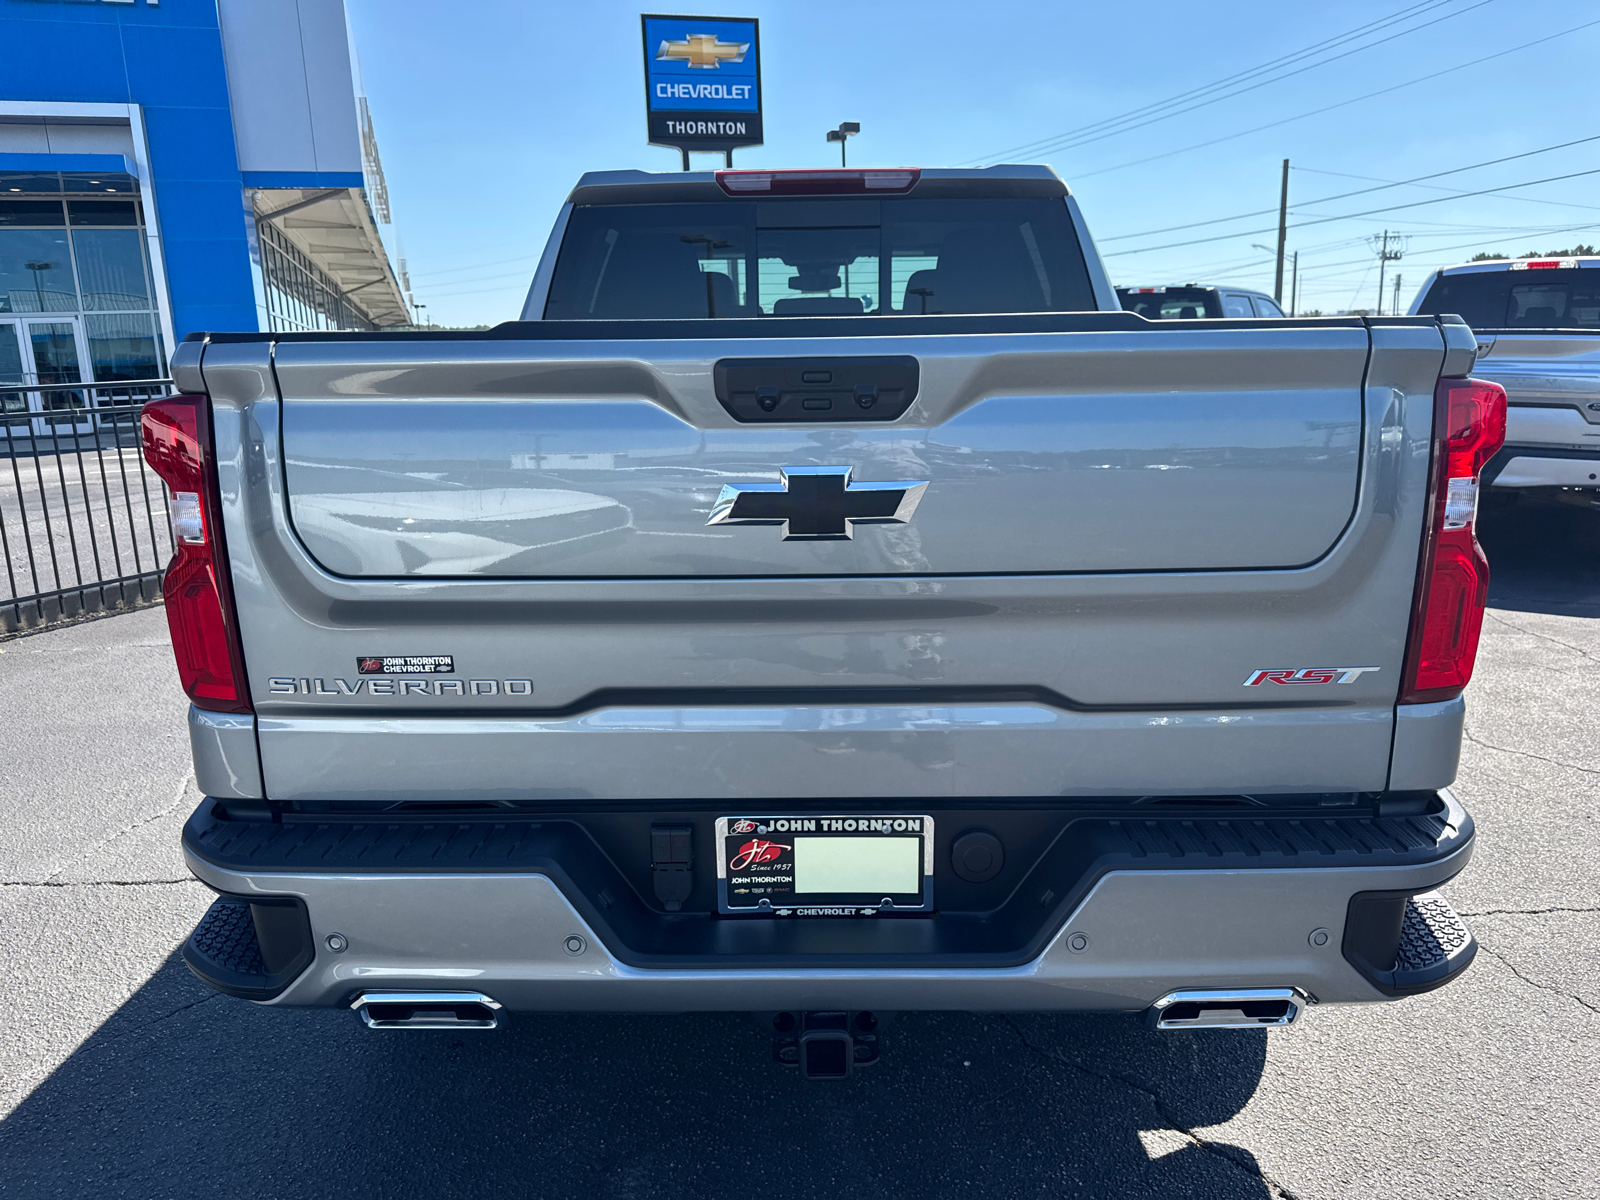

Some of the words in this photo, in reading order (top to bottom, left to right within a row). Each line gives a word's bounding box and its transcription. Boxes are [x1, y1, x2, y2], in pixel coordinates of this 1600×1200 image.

[656, 83, 752, 99] CHEVROLET
[666, 121, 746, 135] THORNTON
[383, 658, 404, 666] JOHN
[404, 657, 452, 665] THORNTON
[383, 665, 436, 673] CHEVROLET
[1242, 665, 1381, 687] RST
[268, 677, 534, 696] SILVERADO
[767, 820, 816, 832] JOHN
[820, 819, 921, 832] THORNTON
[772, 863, 792, 871] 1957
[796, 908, 857, 916] CHEVROLET
